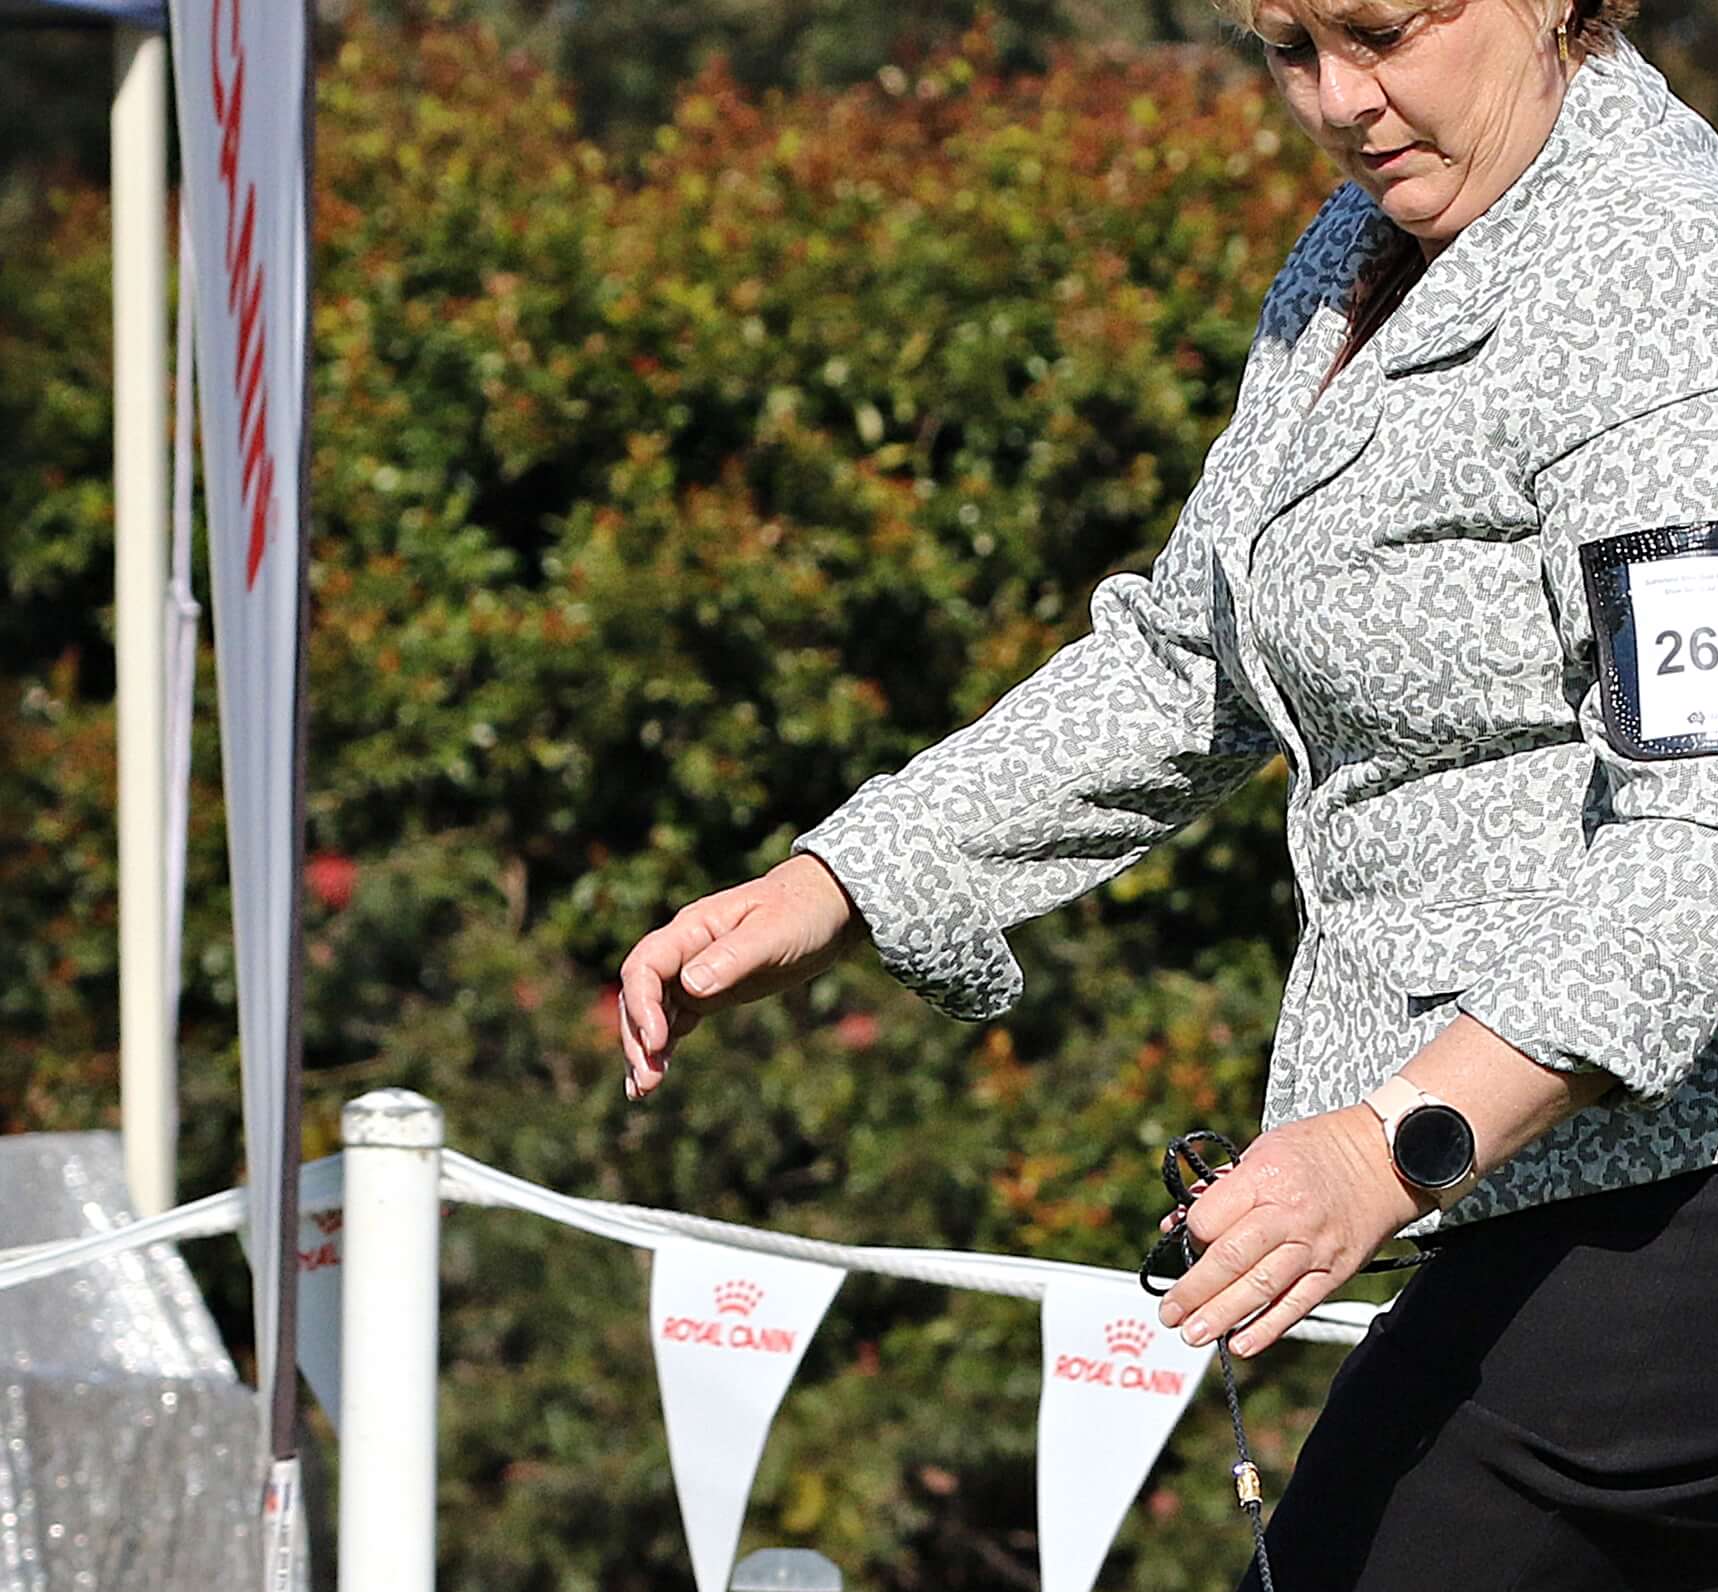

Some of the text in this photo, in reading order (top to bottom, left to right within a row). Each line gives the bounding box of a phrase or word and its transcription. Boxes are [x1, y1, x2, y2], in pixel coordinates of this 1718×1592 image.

[663, 1316, 798, 1353] ROYAL CANIN
[1054, 1354, 1186, 1395] ROYAL CANIN
